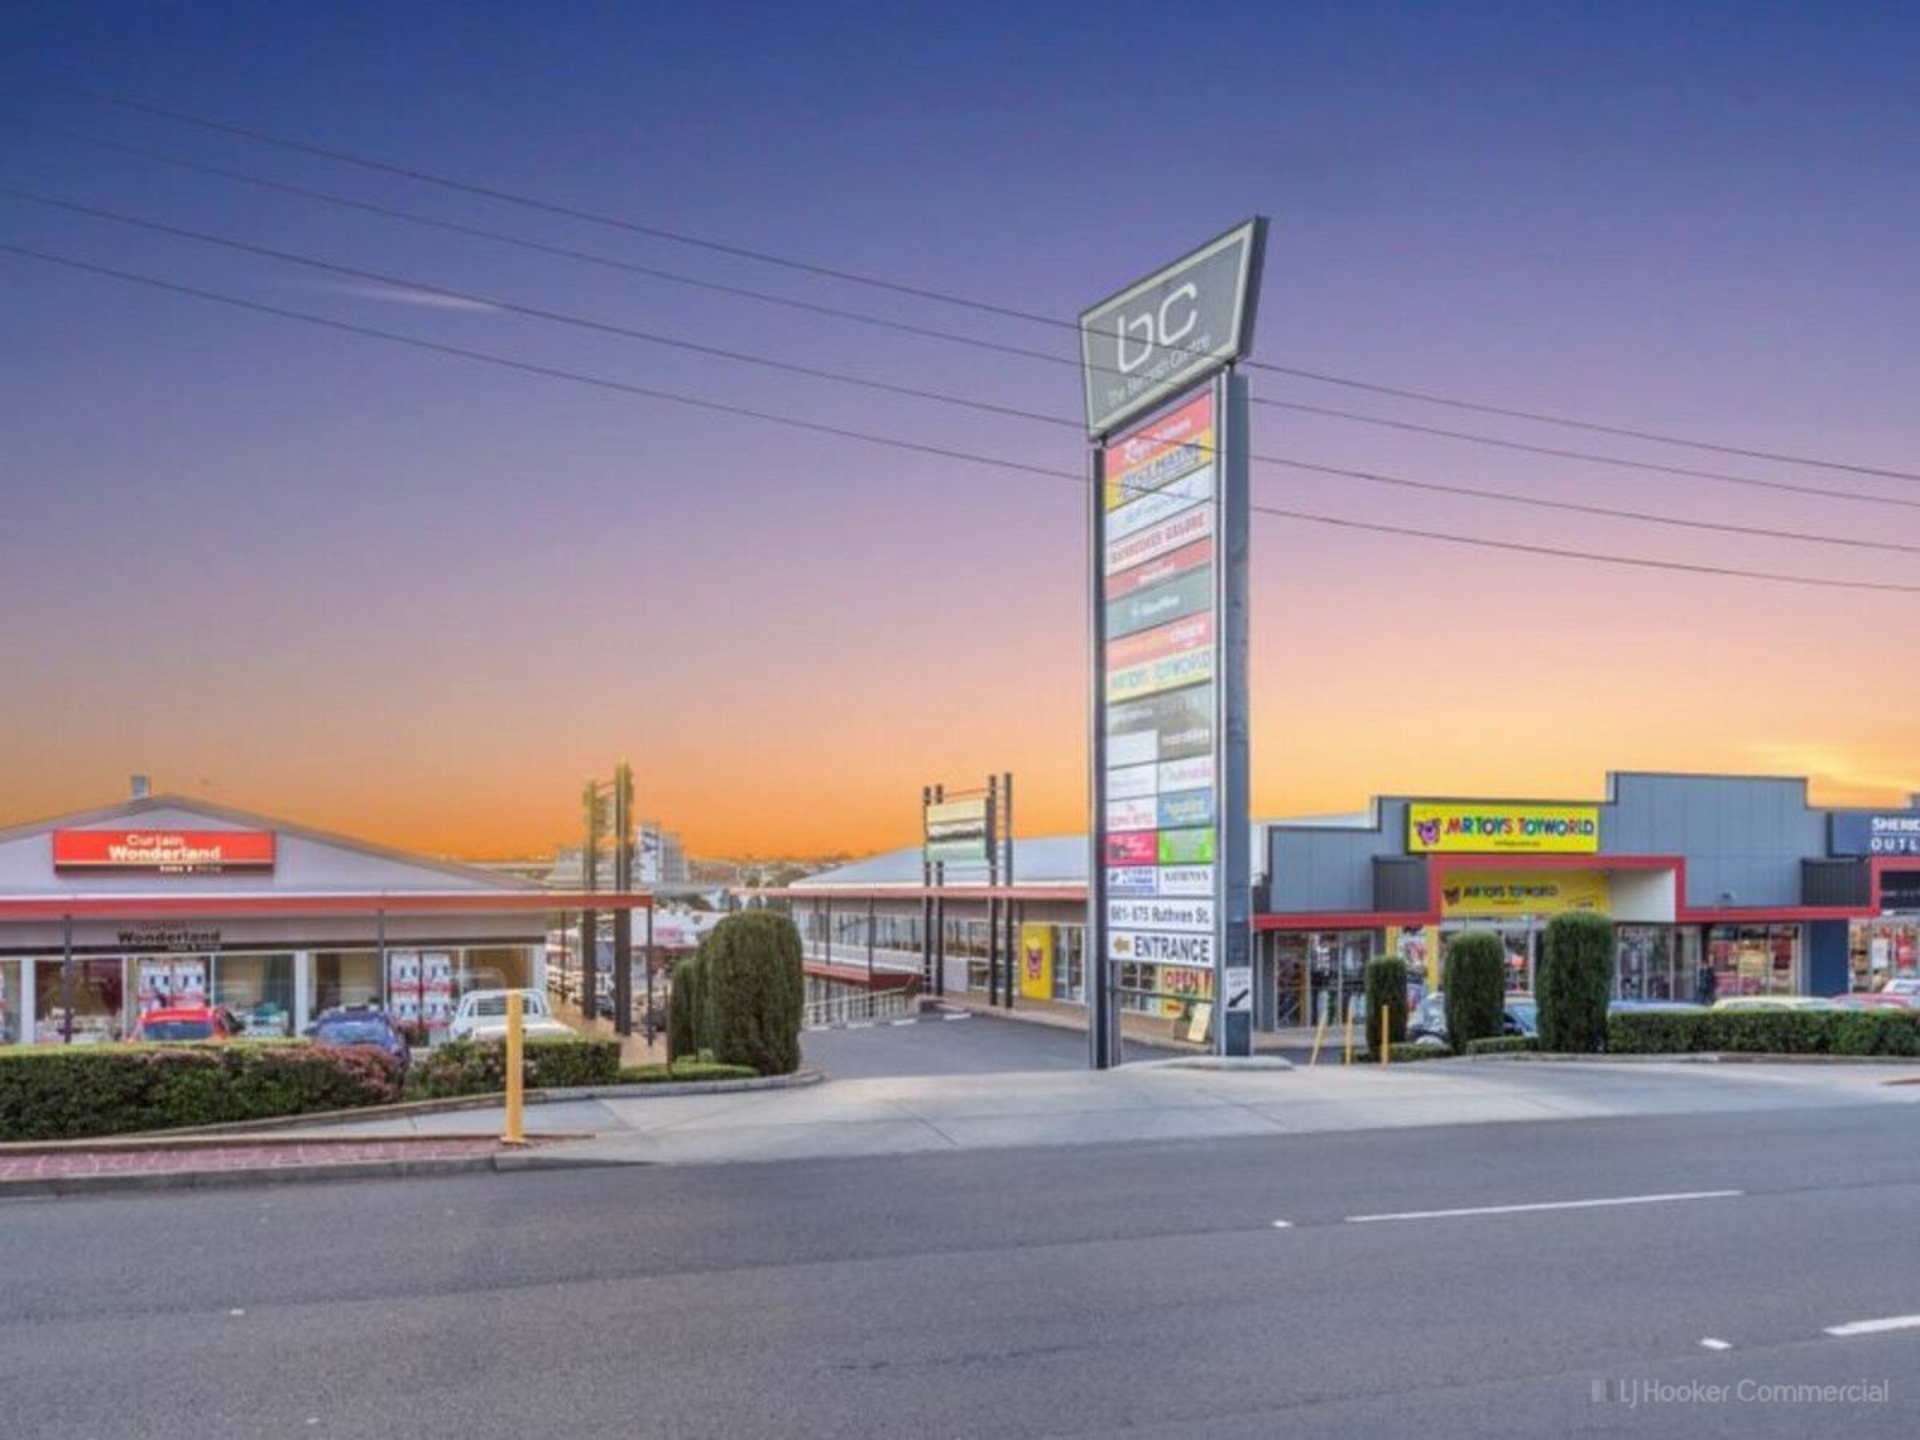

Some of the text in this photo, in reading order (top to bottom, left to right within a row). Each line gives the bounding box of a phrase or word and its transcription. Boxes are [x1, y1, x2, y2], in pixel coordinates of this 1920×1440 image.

[1475, 818, 1513, 836] TOYS
[1517, 818, 1595, 836] TOYWORLD
[126, 834, 184, 847] Curtain
[108, 845, 221, 861] Wonderland
[117, 931, 221, 945] Wonderland
[1134, 935, 1211, 962] ENTRANCE
